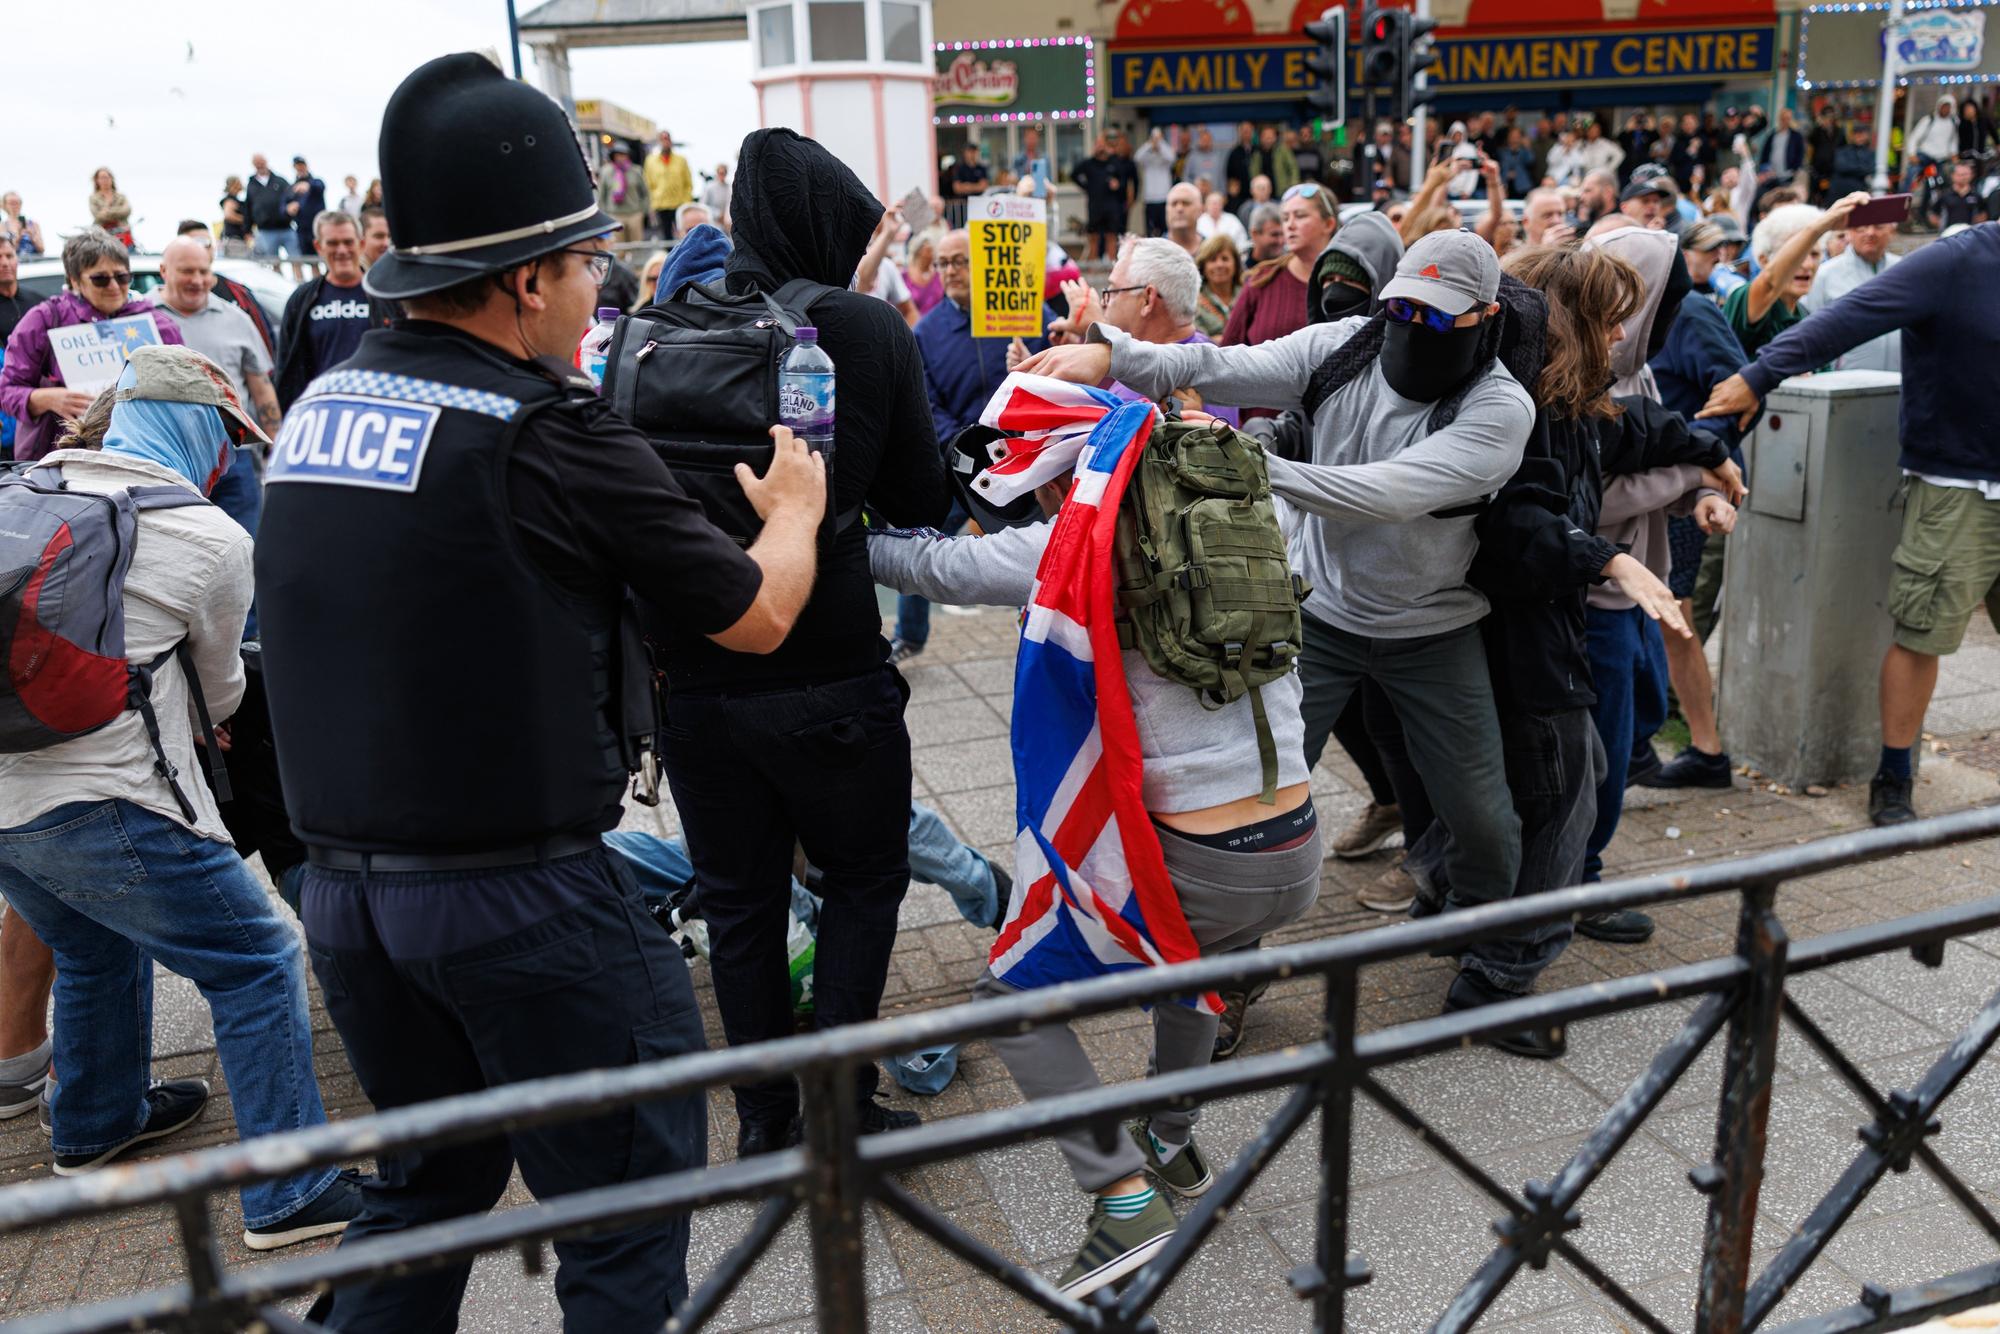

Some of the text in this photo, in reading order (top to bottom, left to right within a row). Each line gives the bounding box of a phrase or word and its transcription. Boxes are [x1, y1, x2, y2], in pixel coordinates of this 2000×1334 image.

[1124, 53, 1268, 94] FAMILY
[1611, 33, 1759, 75] CENTRE
[982, 222, 1032, 243] STOP
[983, 245, 1021, 266] THE
[985, 268, 1021, 288] FAR
[309, 299, 370, 321] adida
[985, 291, 1037, 311] RIGHT
[60, 332, 98, 351] ONE
[77, 349, 117, 368] CITY
[269, 409, 421, 474] POLICE
[1228, 839, 1240, 847] TED
